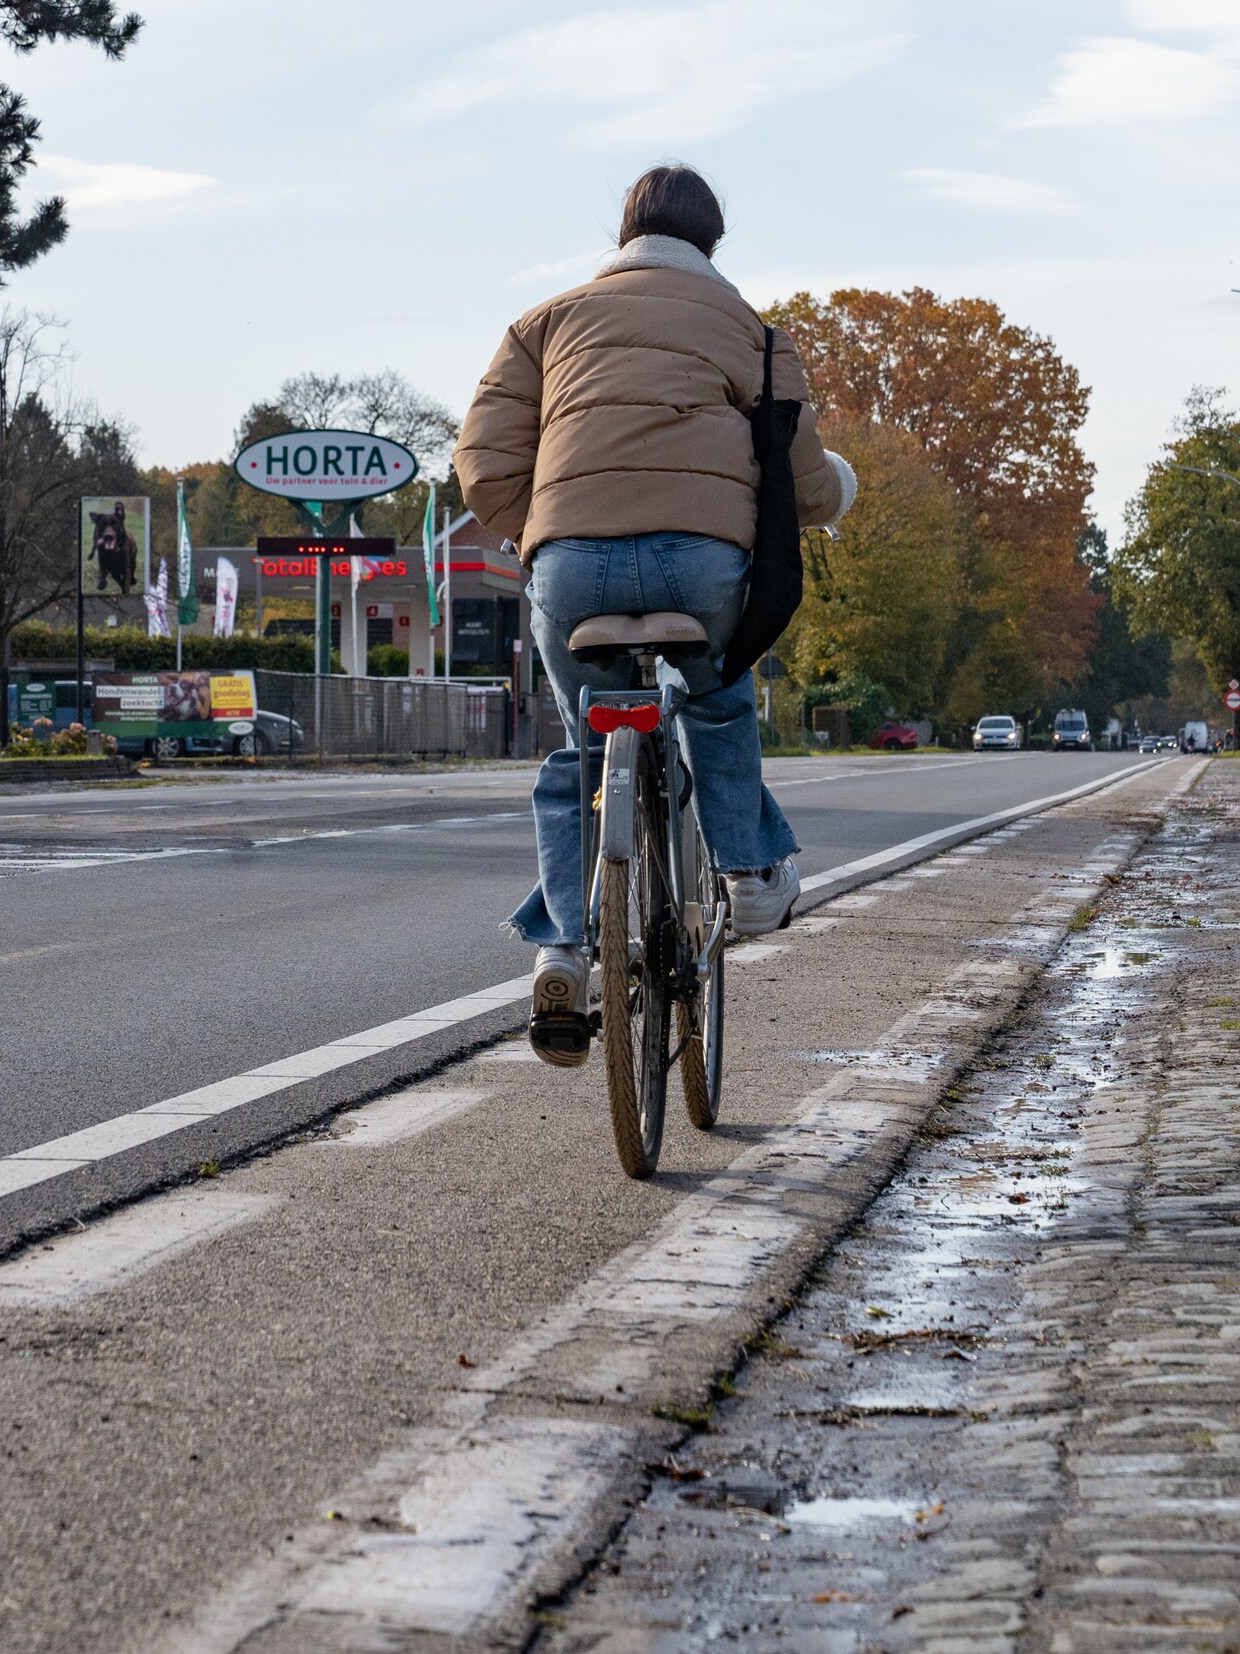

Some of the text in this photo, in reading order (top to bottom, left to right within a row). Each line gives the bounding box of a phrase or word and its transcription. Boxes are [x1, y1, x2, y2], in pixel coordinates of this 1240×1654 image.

[266, 445, 387, 476] HORTA
[266, 477, 280, 485] Uw
[282, 477, 316, 486] partner
[340, 477, 359, 485] tuin
[369, 477, 388, 485] dier
[252, 558, 407, 581] TotalEnees
[132, 676, 159, 684] HORTA
